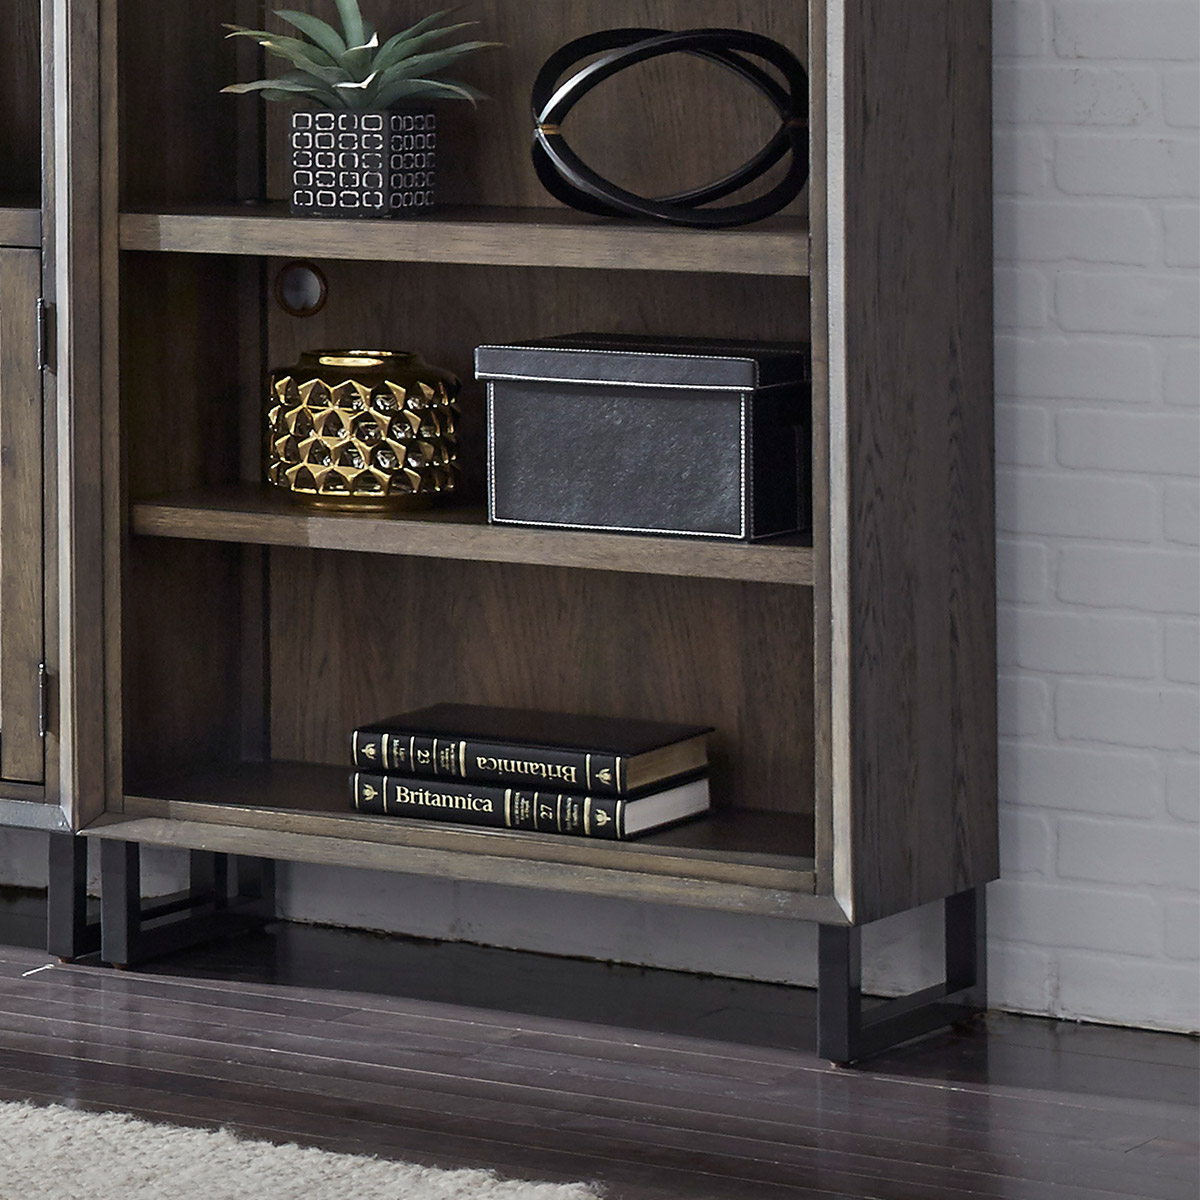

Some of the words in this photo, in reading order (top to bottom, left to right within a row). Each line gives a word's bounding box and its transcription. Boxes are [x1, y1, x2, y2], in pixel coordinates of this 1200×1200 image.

[416, 749, 430, 765] 23
[476, 756, 577, 783] Britannica
[395, 785, 494, 813] Britannica
[540, 804, 554, 819] 27
